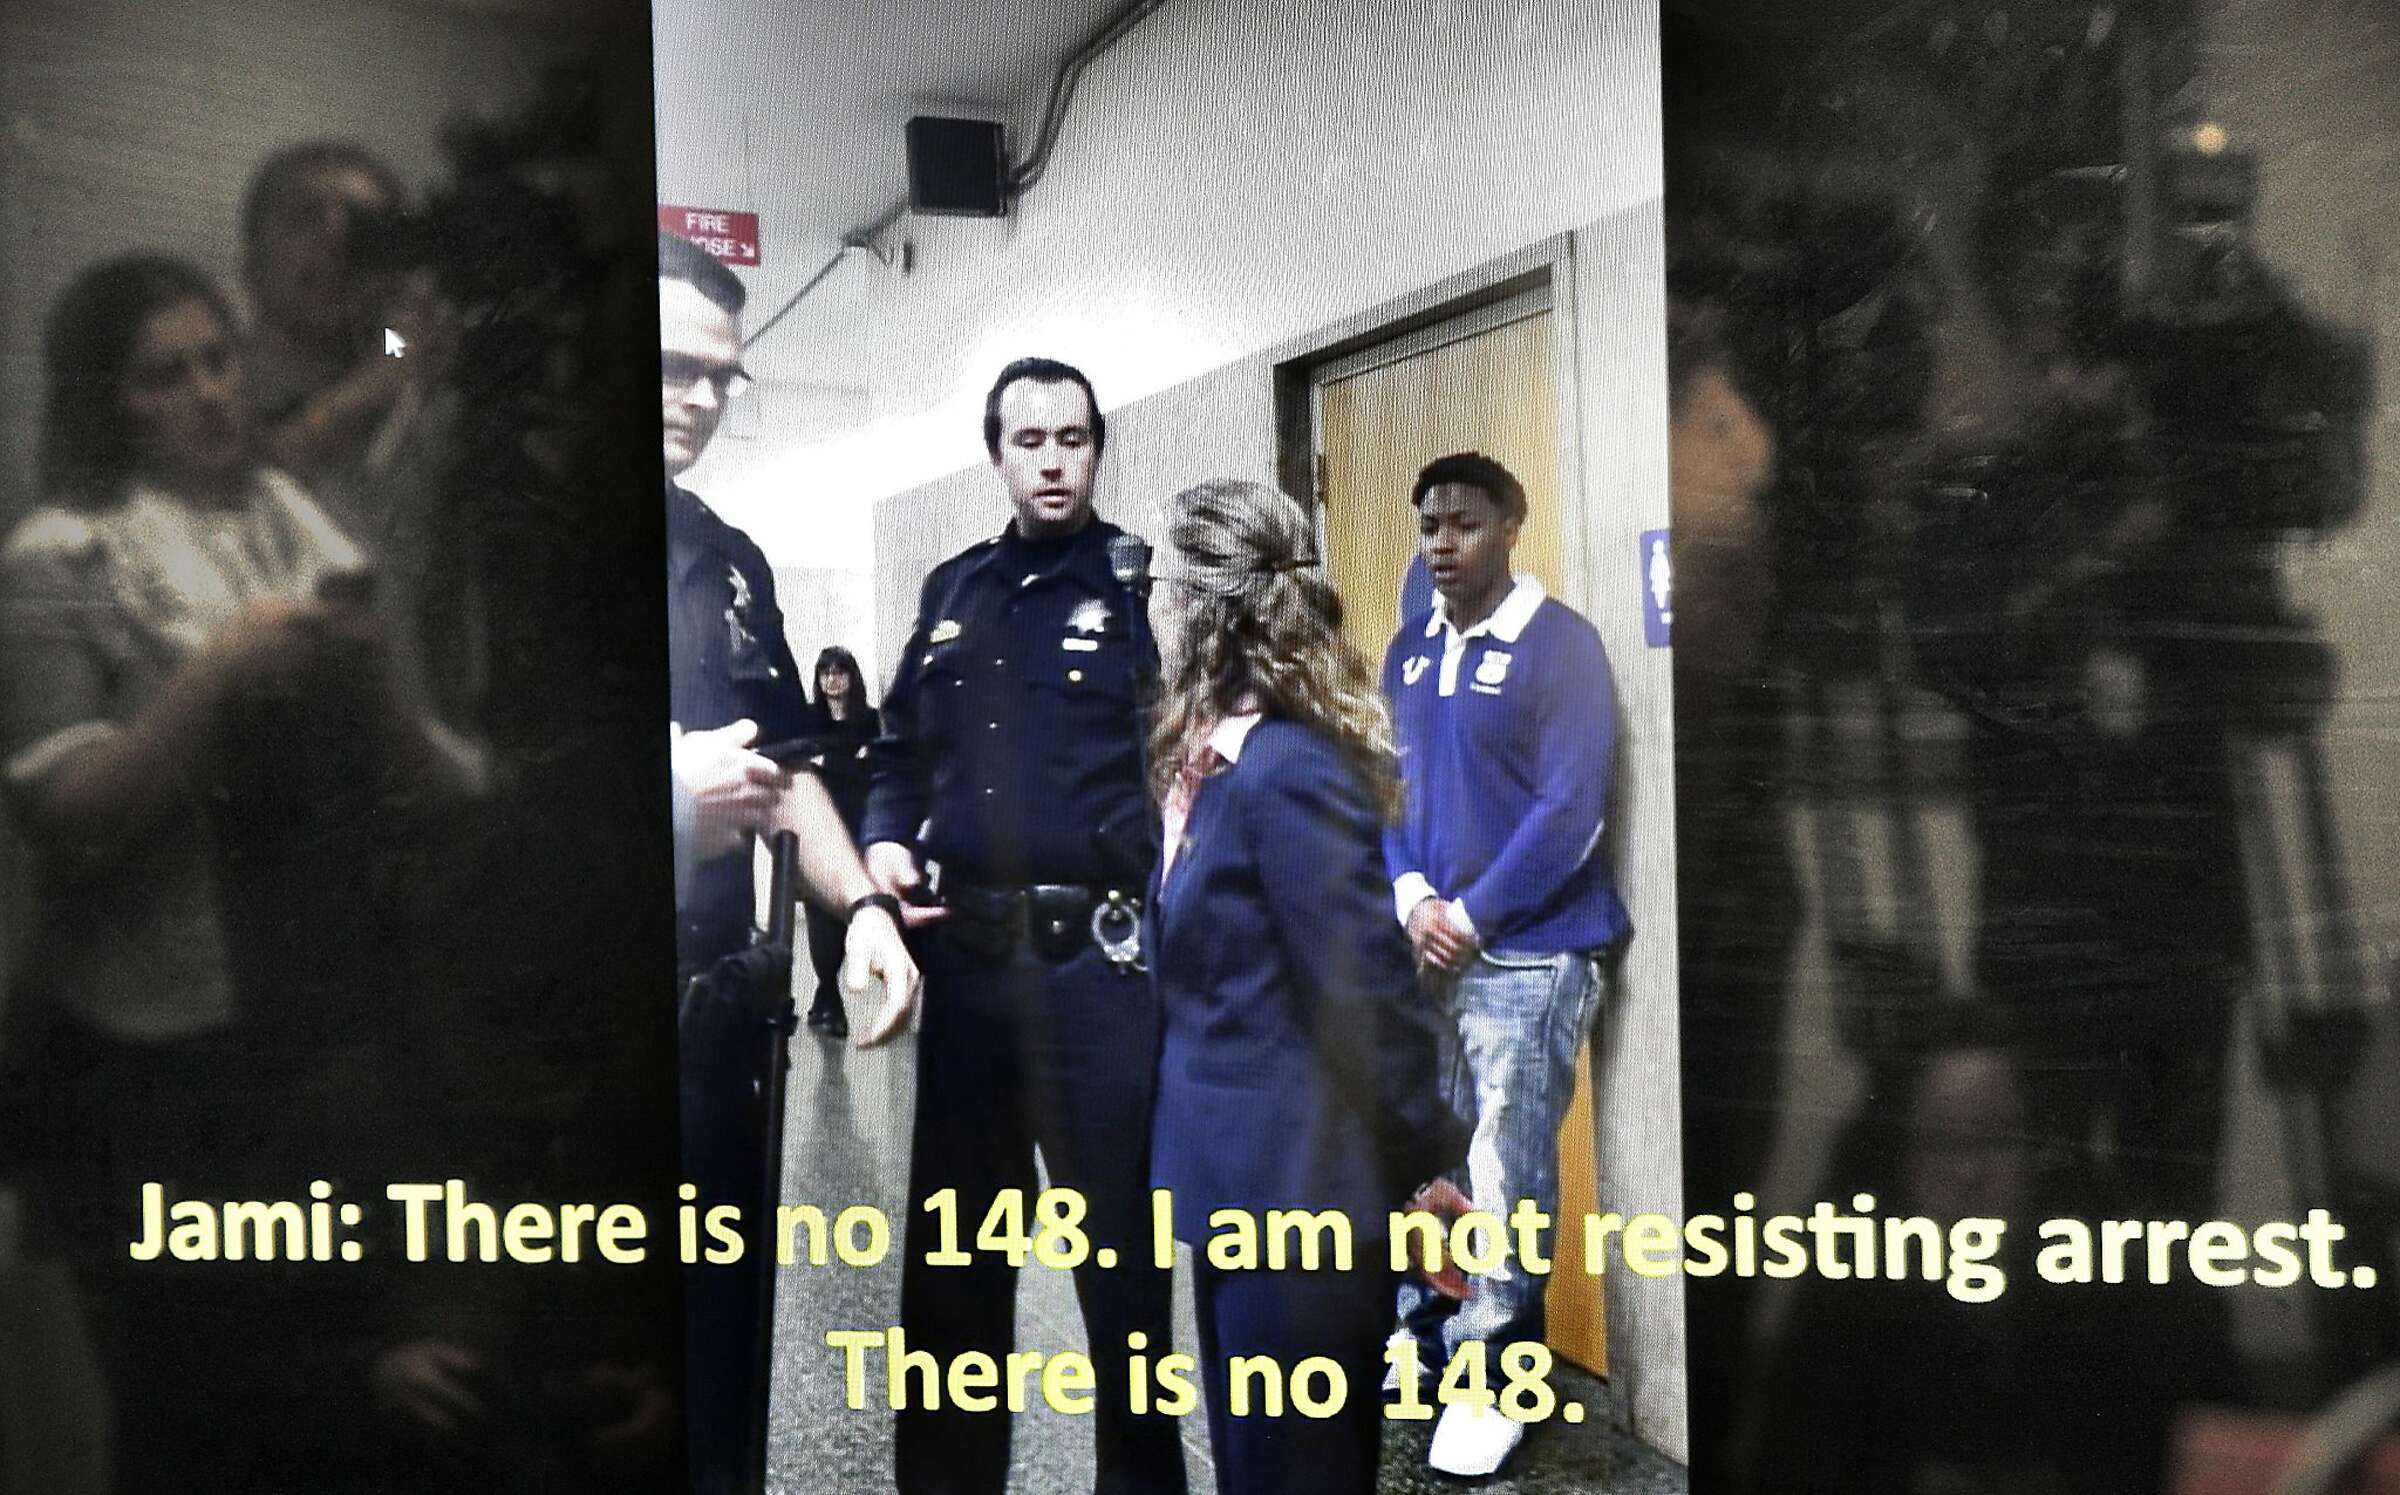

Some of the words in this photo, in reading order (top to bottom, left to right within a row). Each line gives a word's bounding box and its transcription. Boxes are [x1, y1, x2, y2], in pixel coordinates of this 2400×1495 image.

[685, 212, 730, 233] FIRE
[690, 235, 737, 257] OSE
[129, 1179, 363, 1262] Jami:
[386, 1178, 648, 1264] There
[678, 1182, 746, 1265] is
[776, 1203, 890, 1267] no
[922, 1187, 1117, 1271] 148.
[1152, 1188, 1176, 1270] I
[1206, 1207, 1354, 1272] am
[1388, 1198, 1552, 1277] not
[1582, 1191, 2009, 1303] resisting
[2035, 1208, 2377, 1290] arrest.
[825, 1325, 1097, 1415] There
[1127, 1330, 1198, 1417] is
[1228, 1352, 1349, 1419] no
[1383, 1340, 1586, 1424] 148.
